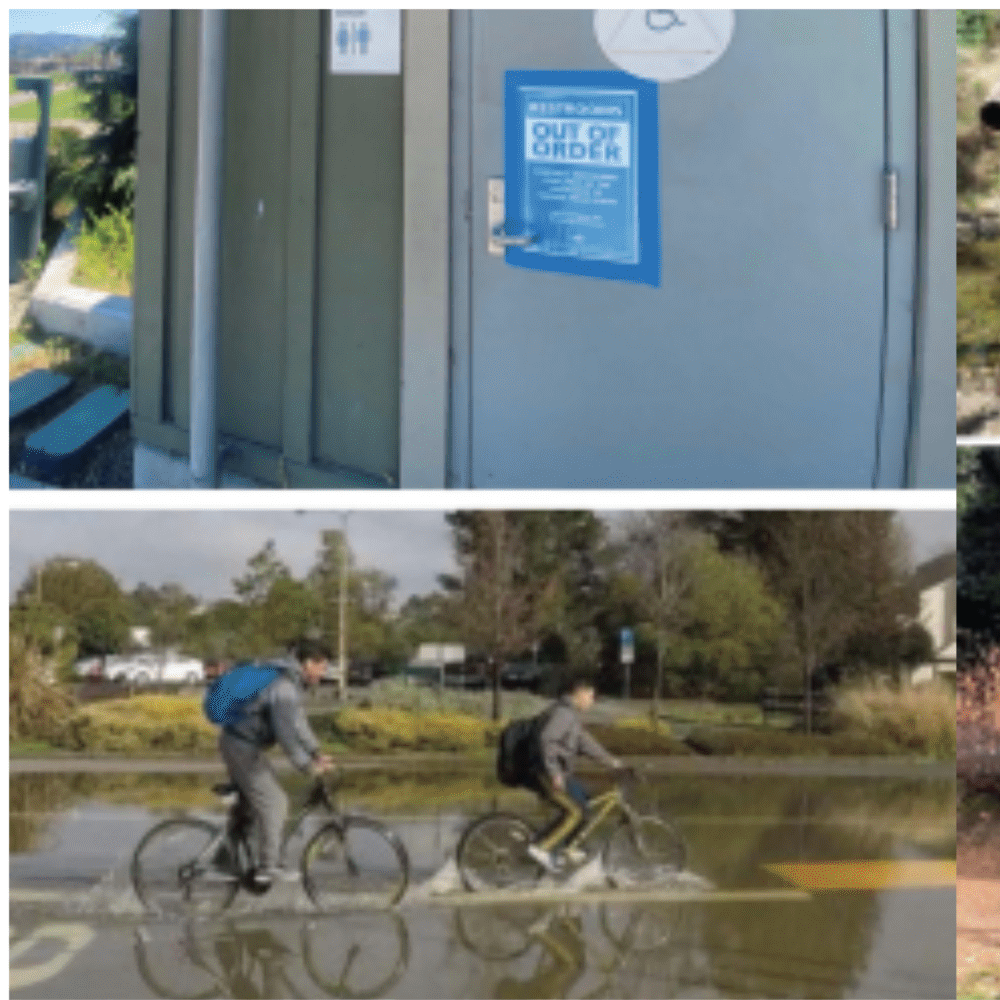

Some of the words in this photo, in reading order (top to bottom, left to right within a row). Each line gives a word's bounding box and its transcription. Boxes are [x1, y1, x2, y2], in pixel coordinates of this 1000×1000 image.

[532, 122, 580, 140] OUT
[588, 125, 621, 141] OF
[532, 141, 622, 162] ORDER
